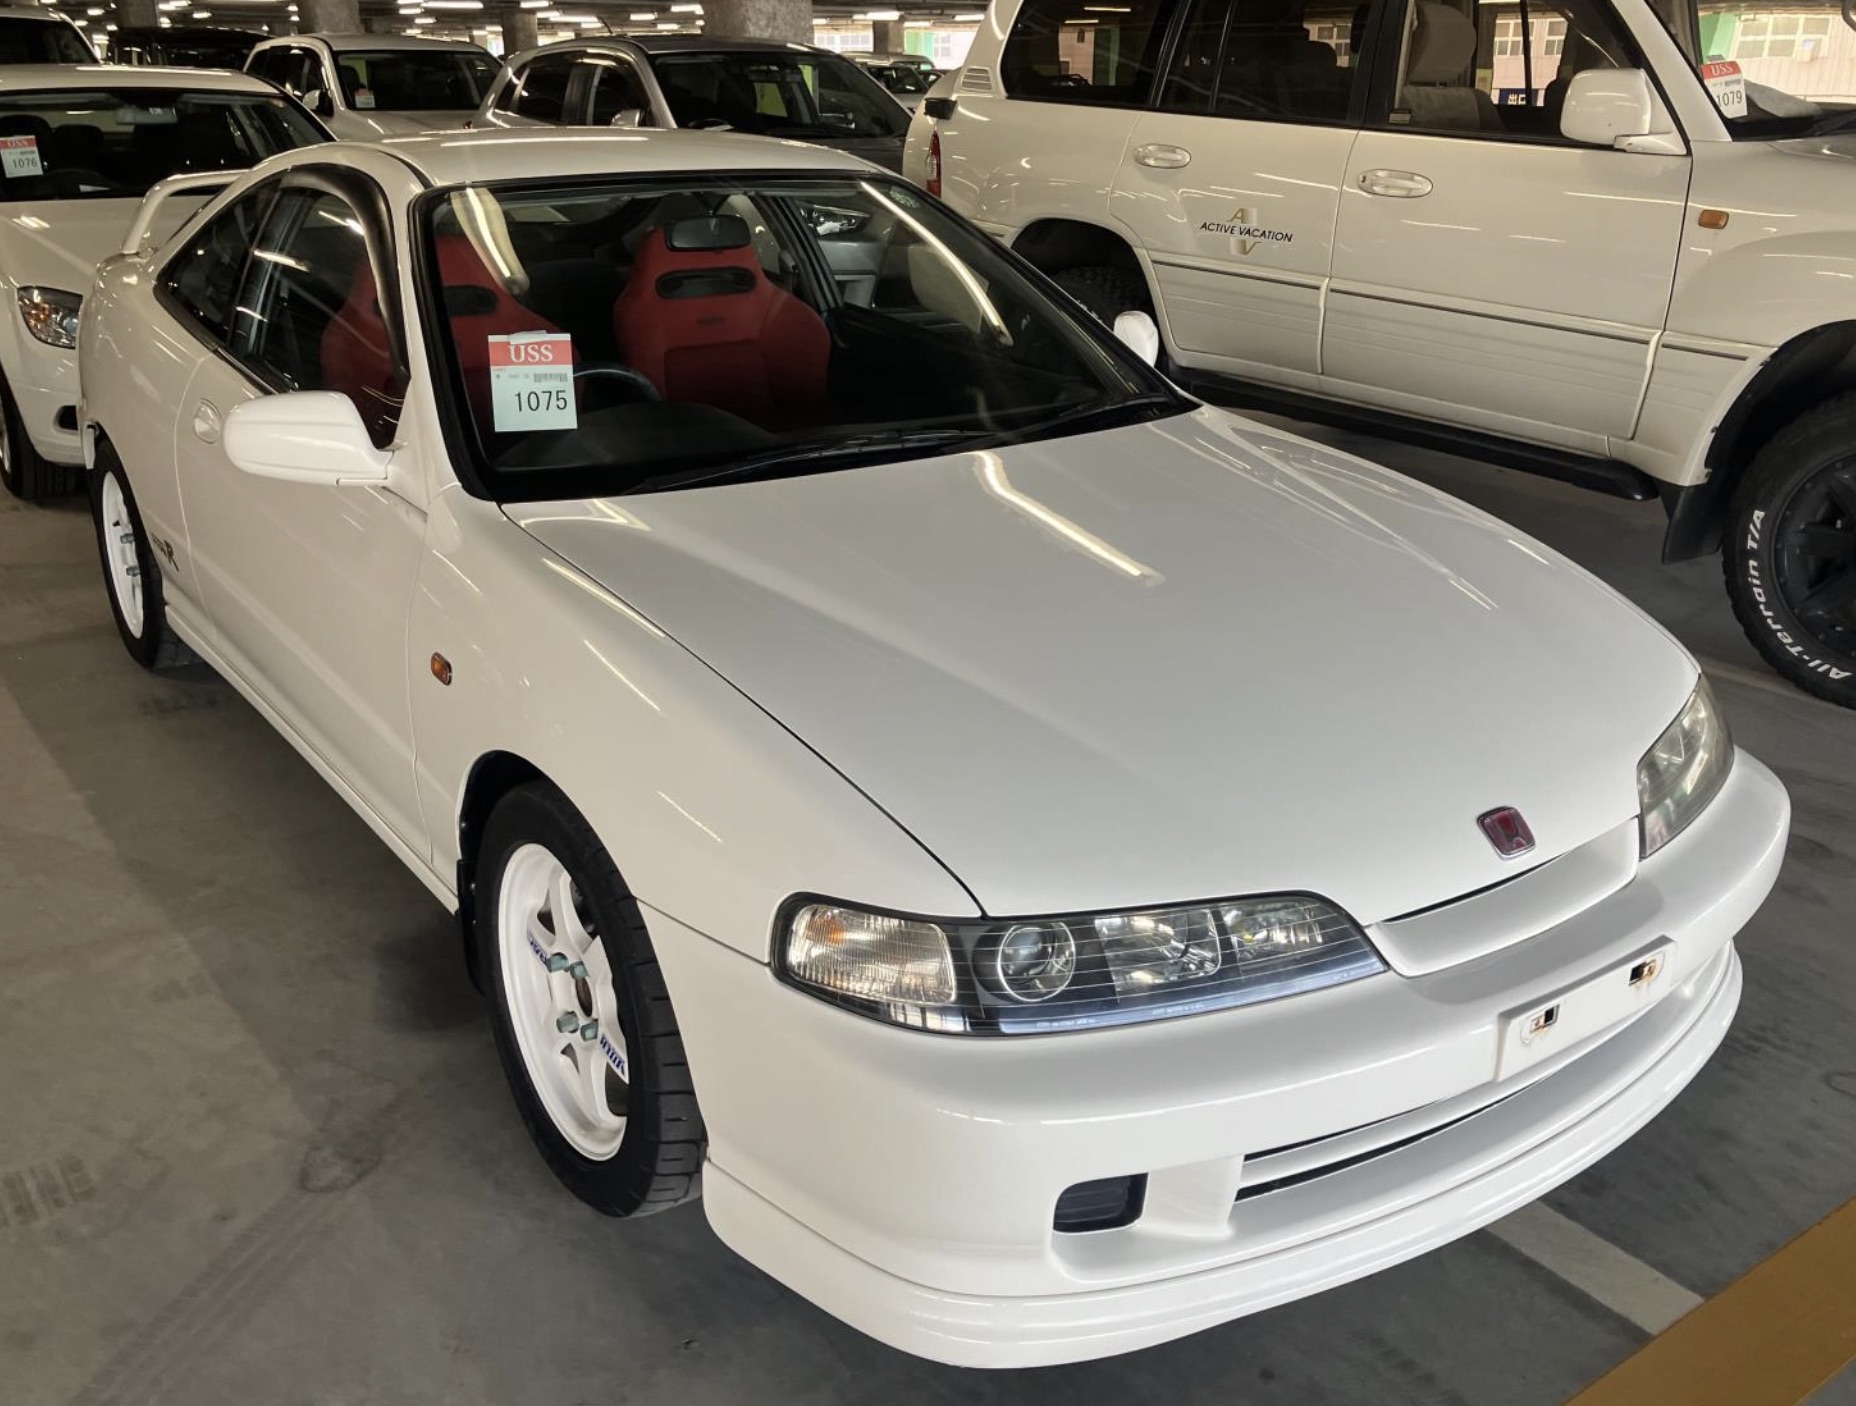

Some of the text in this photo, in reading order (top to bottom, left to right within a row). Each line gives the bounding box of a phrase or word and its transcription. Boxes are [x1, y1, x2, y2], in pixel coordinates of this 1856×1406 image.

[1710, 63, 1733, 76] USS
[1716, 90, 1742, 107] 1079
[12, 157, 38, 168] 1076
[1200, 222, 1293, 242] ACTIVE VACATION
[509, 343, 553, 362] USS
[514, 389, 568, 412] 1075
[1747, 509, 1852, 679] All-Terrain T/A
